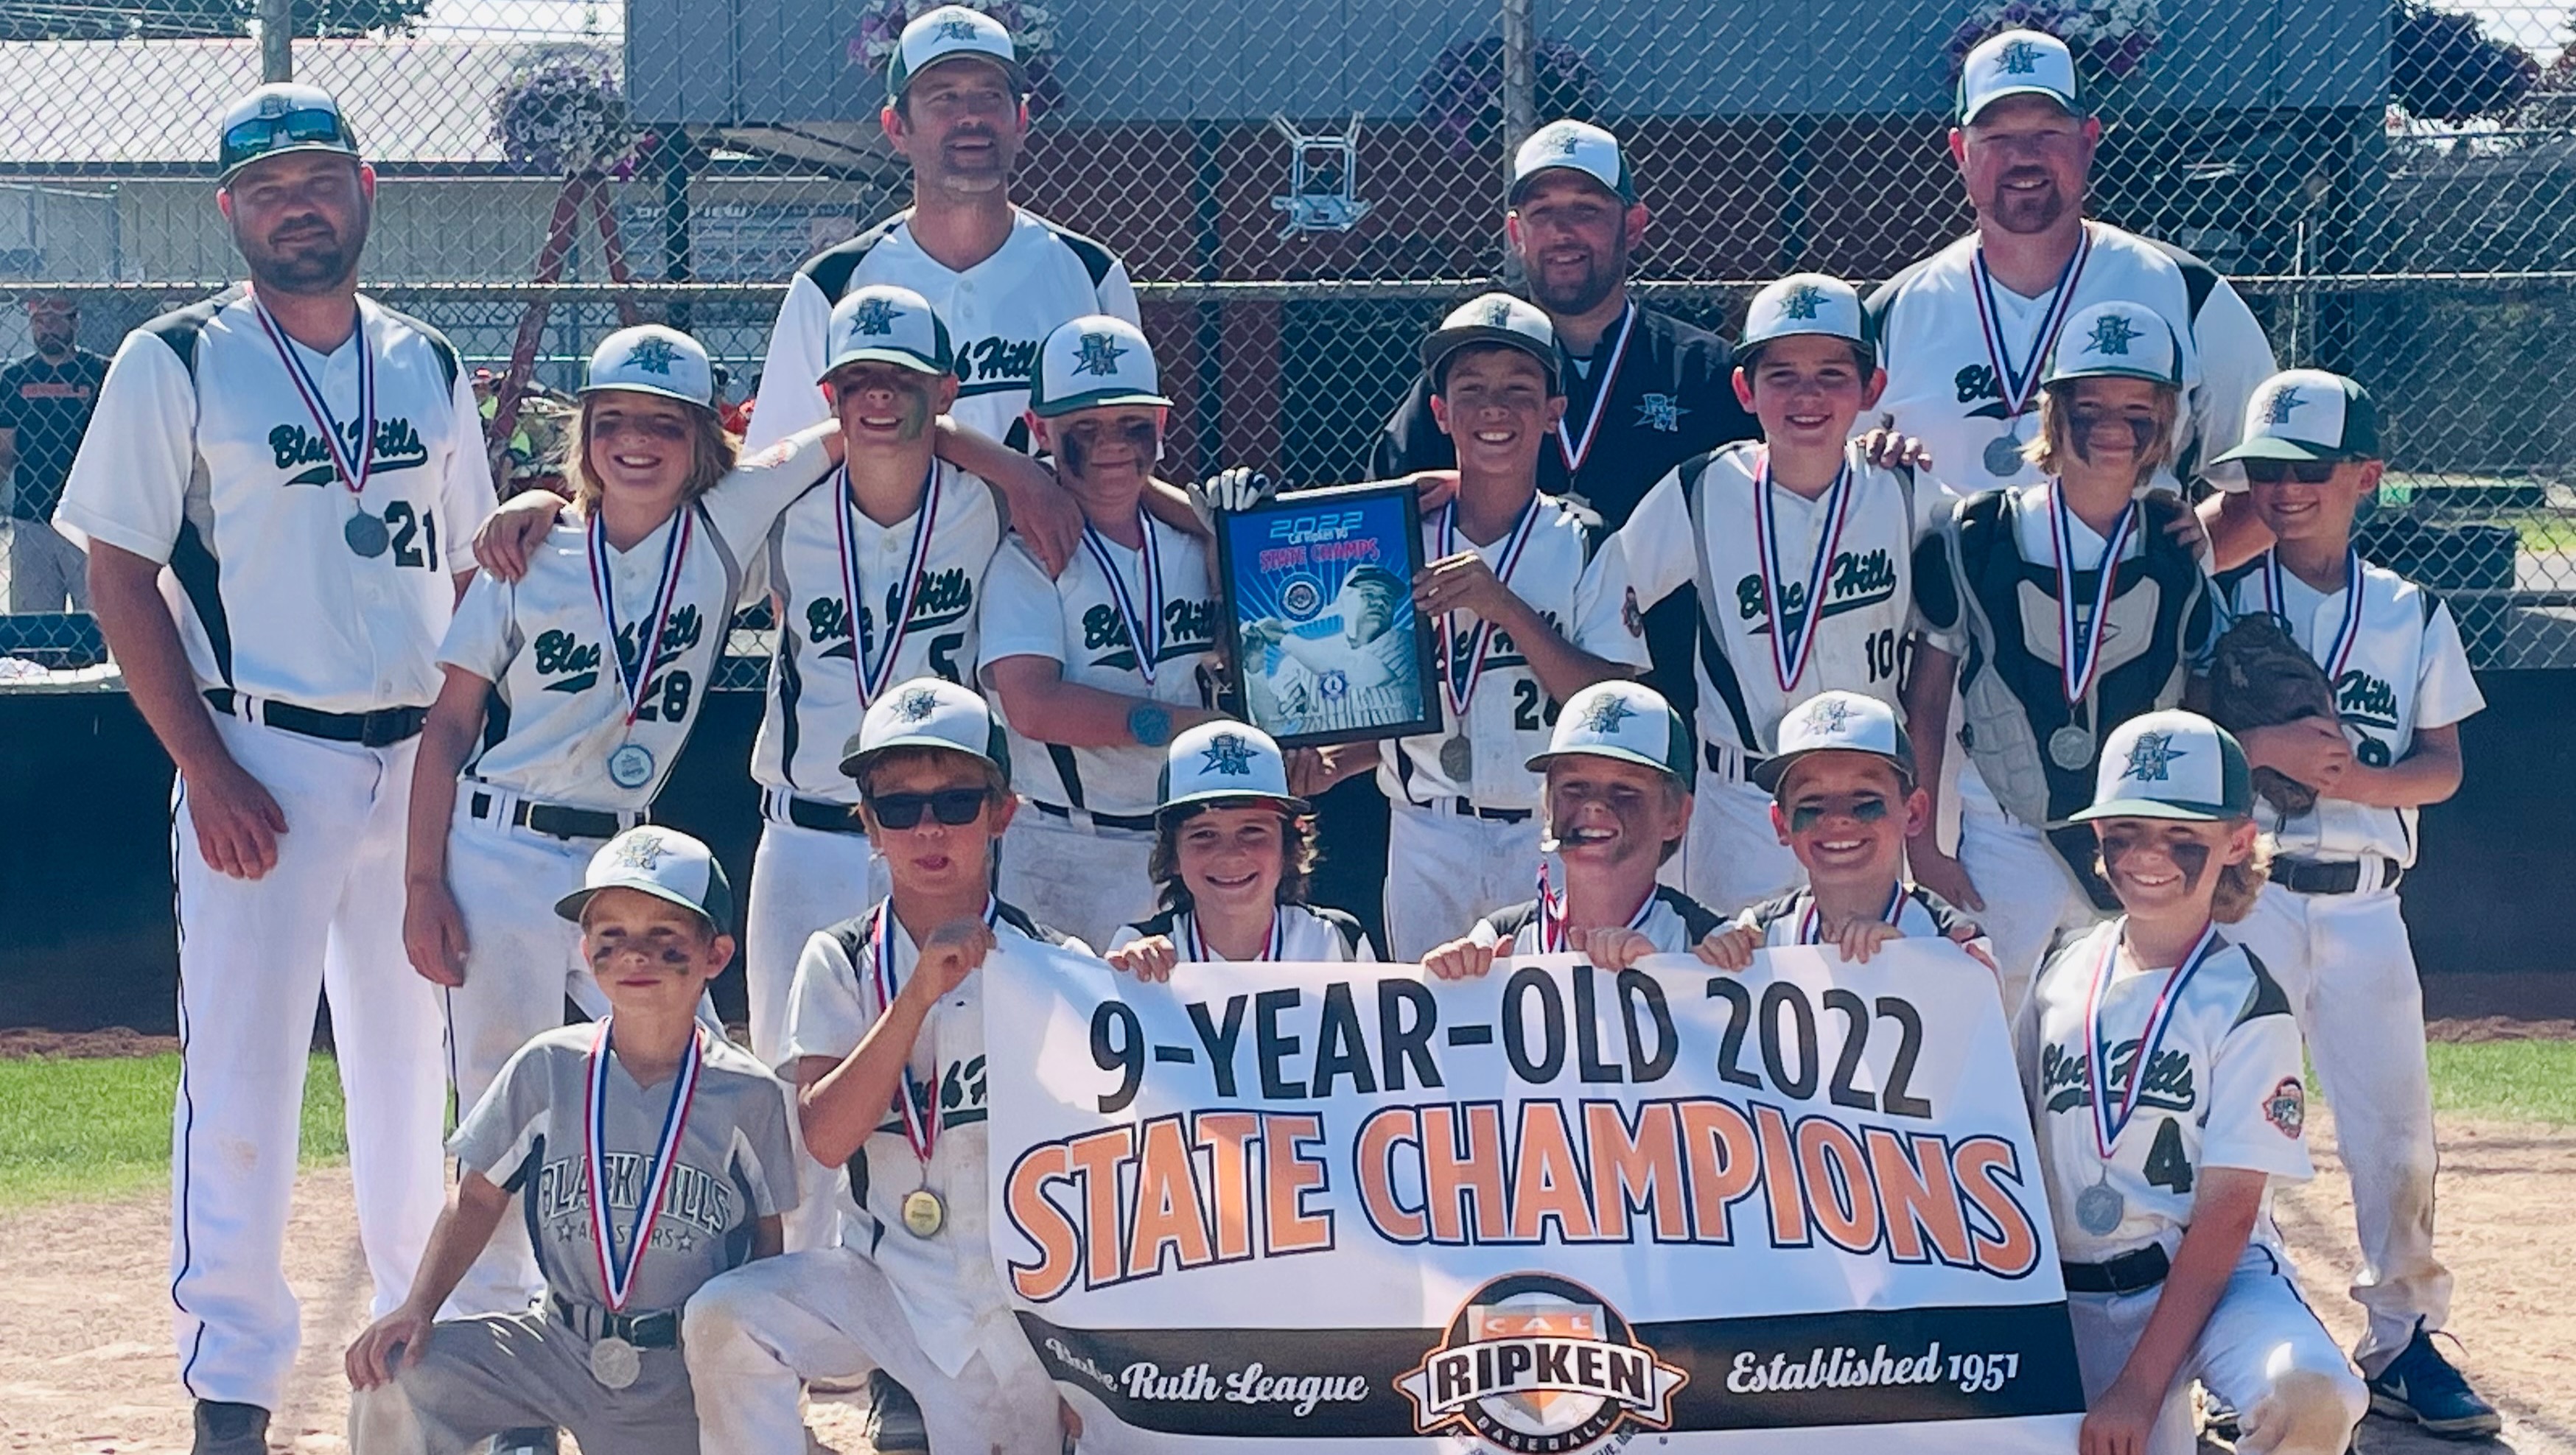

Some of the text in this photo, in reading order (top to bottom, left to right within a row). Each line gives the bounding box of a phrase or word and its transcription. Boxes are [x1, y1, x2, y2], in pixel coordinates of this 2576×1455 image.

[973, 336, 1037, 380] Hill
[384, 500, 438, 572] 21
[1270, 511, 1363, 539] 2022
[1311, 538, 1381, 562] CHAMPS
[1865, 628, 1894, 683] 10
[1089, 965, 1932, 1118] 9-YEAR-OLD 2022
[2142, 1117, 2194, 1194] 4
[1004, 1096, 2042, 1303] STATE CHAMPIONS
[1485, 1316, 1590, 1333] CAL
[1121, 1361, 1223, 1400] Ruth
[1224, 1361, 1370, 1417] League
[1726, 1341, 1943, 1393] Established
[1947, 1352, 2020, 1393] 1951
[1435, 1343, 1648, 1405] RIPKEN
[1477, 1414, 1610, 1451] BASEBALL
